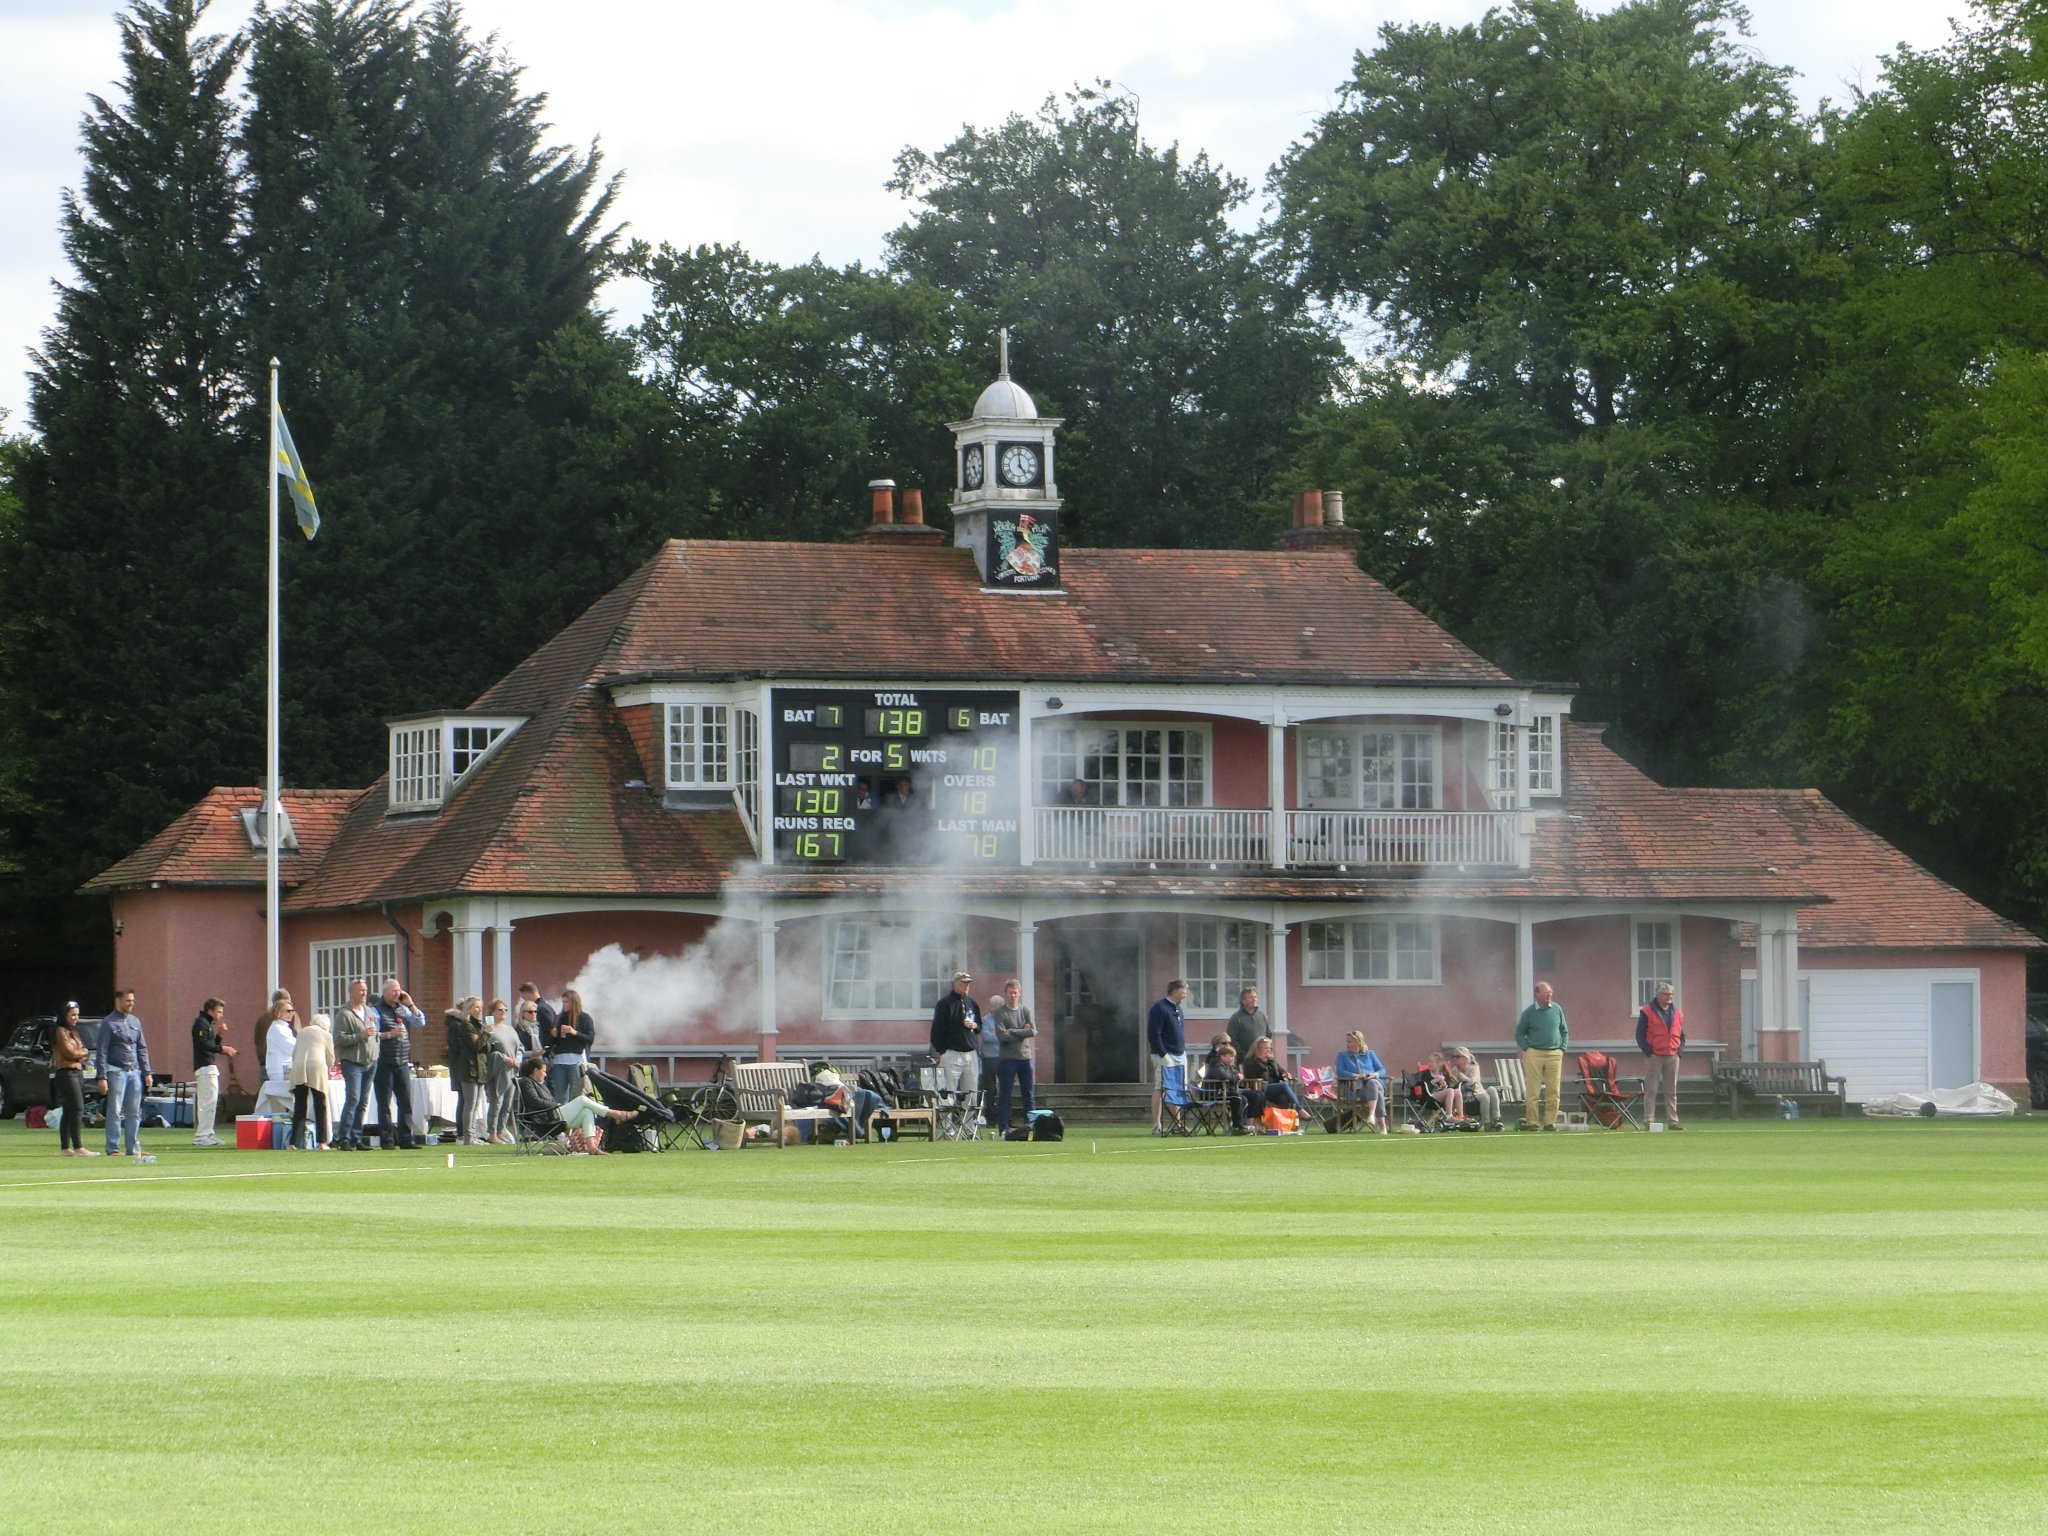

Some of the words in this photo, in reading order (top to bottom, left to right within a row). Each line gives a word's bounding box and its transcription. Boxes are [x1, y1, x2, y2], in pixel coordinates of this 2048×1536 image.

[875, 694, 918, 706] TOTAL
[784, 710, 815, 722] BAT
[828, 708, 839, 724] 7
[878, 711, 922, 735] 138
[958, 709, 970, 727] 6
[980, 713, 1009, 725] BAT
[823, 746, 839, 770] 2
[851, 750, 882, 762] FOR
[887, 744, 903, 768] 5
[911, 751, 946, 763] WKTS
[973, 747, 996, 770] 10
[776, 774, 815, 785] LAST
[821, 774, 856, 786] WKT
[944, 775, 995, 787] OVERS
[795, 790, 839, 814] 130
[963, 792, 986, 814] 18
[774, 818, 818, 829] RUNS
[823, 818, 855, 831] REQ
[939, 820, 977, 831] LAST
[982, 820, 1016, 832] MAN
[796, 834, 839, 857] 167
